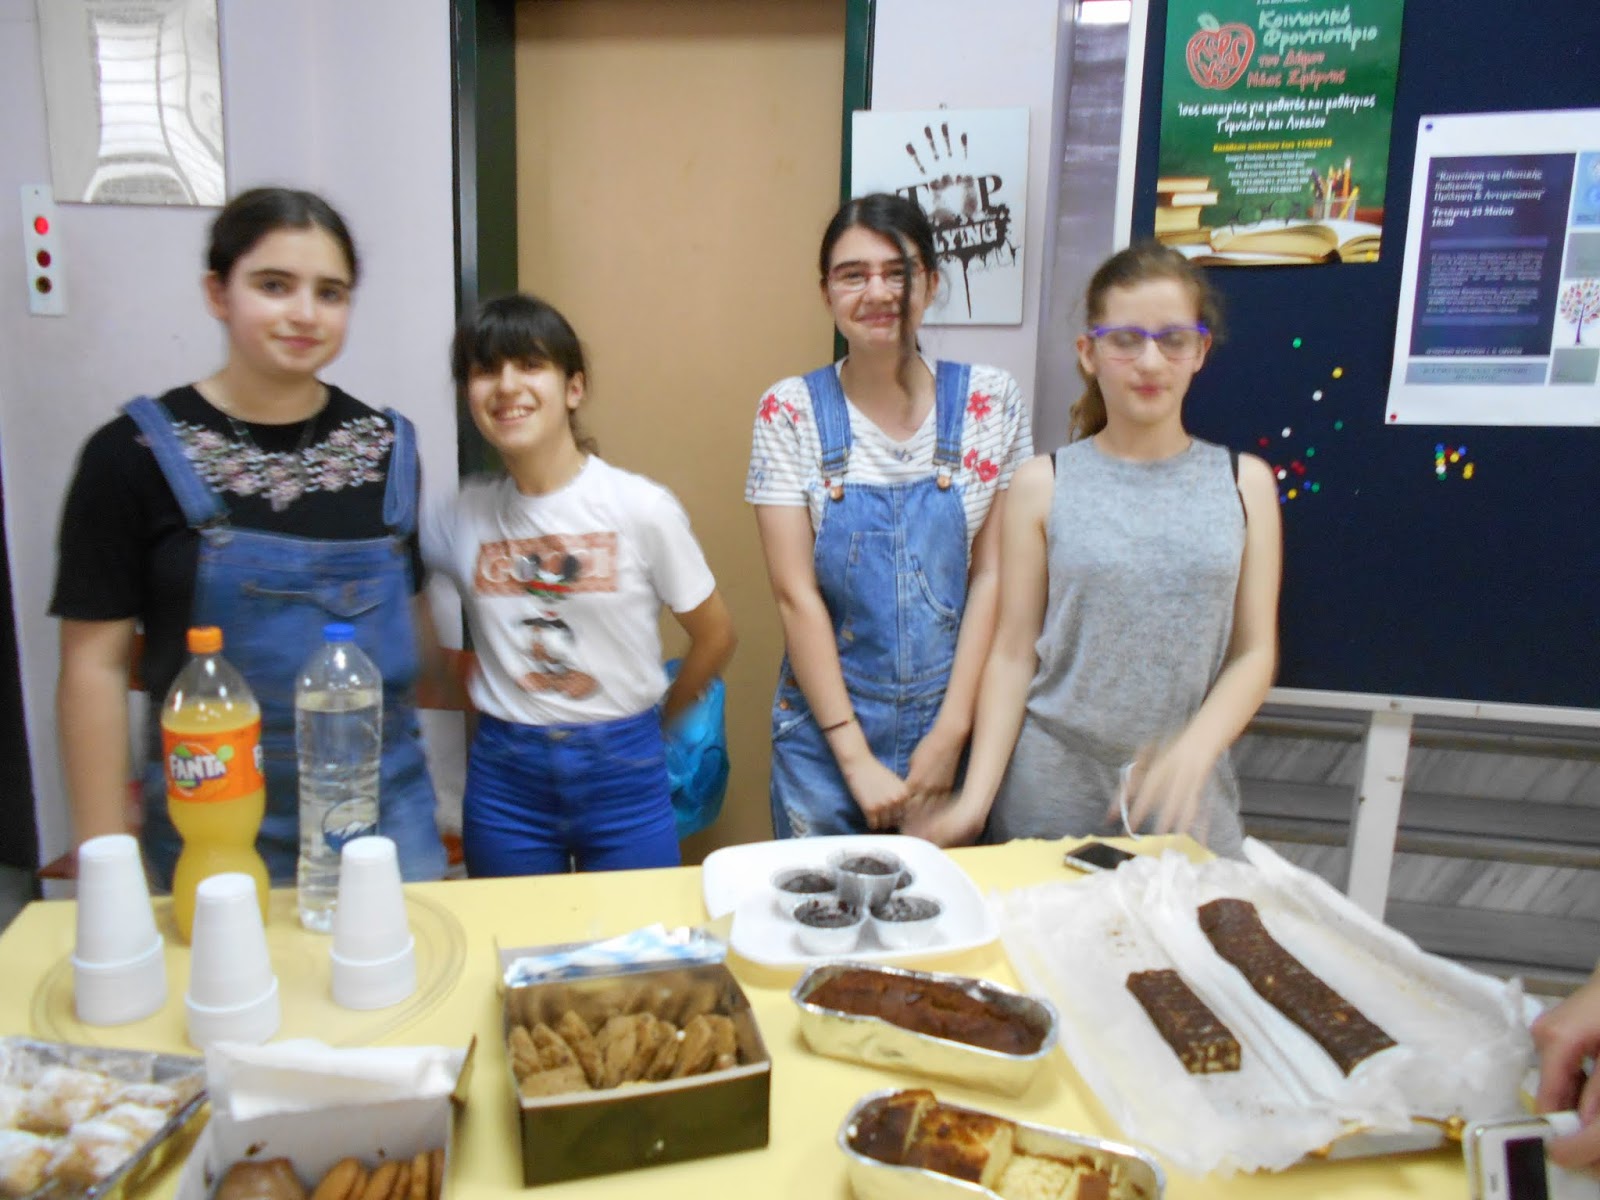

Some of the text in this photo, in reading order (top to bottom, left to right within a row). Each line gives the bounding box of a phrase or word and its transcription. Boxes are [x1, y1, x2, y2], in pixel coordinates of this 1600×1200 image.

[1258, 4, 1350, 29] Κοινωνικό
[1263, 23, 1378, 55] Φροντιστήριο
[1202, 98, 1248, 120] ευκαιρίες
[1249, 100, 1264, 118] για
[1266, 95, 1306, 117] μαθητές
[1308, 97, 1324, 110] και
[1326, 93, 1376, 114] μαθήτριες
[1217, 114, 1326, 138] Γυμνασίου και Λυκείου
[169, 754, 227, 781] FANTA
